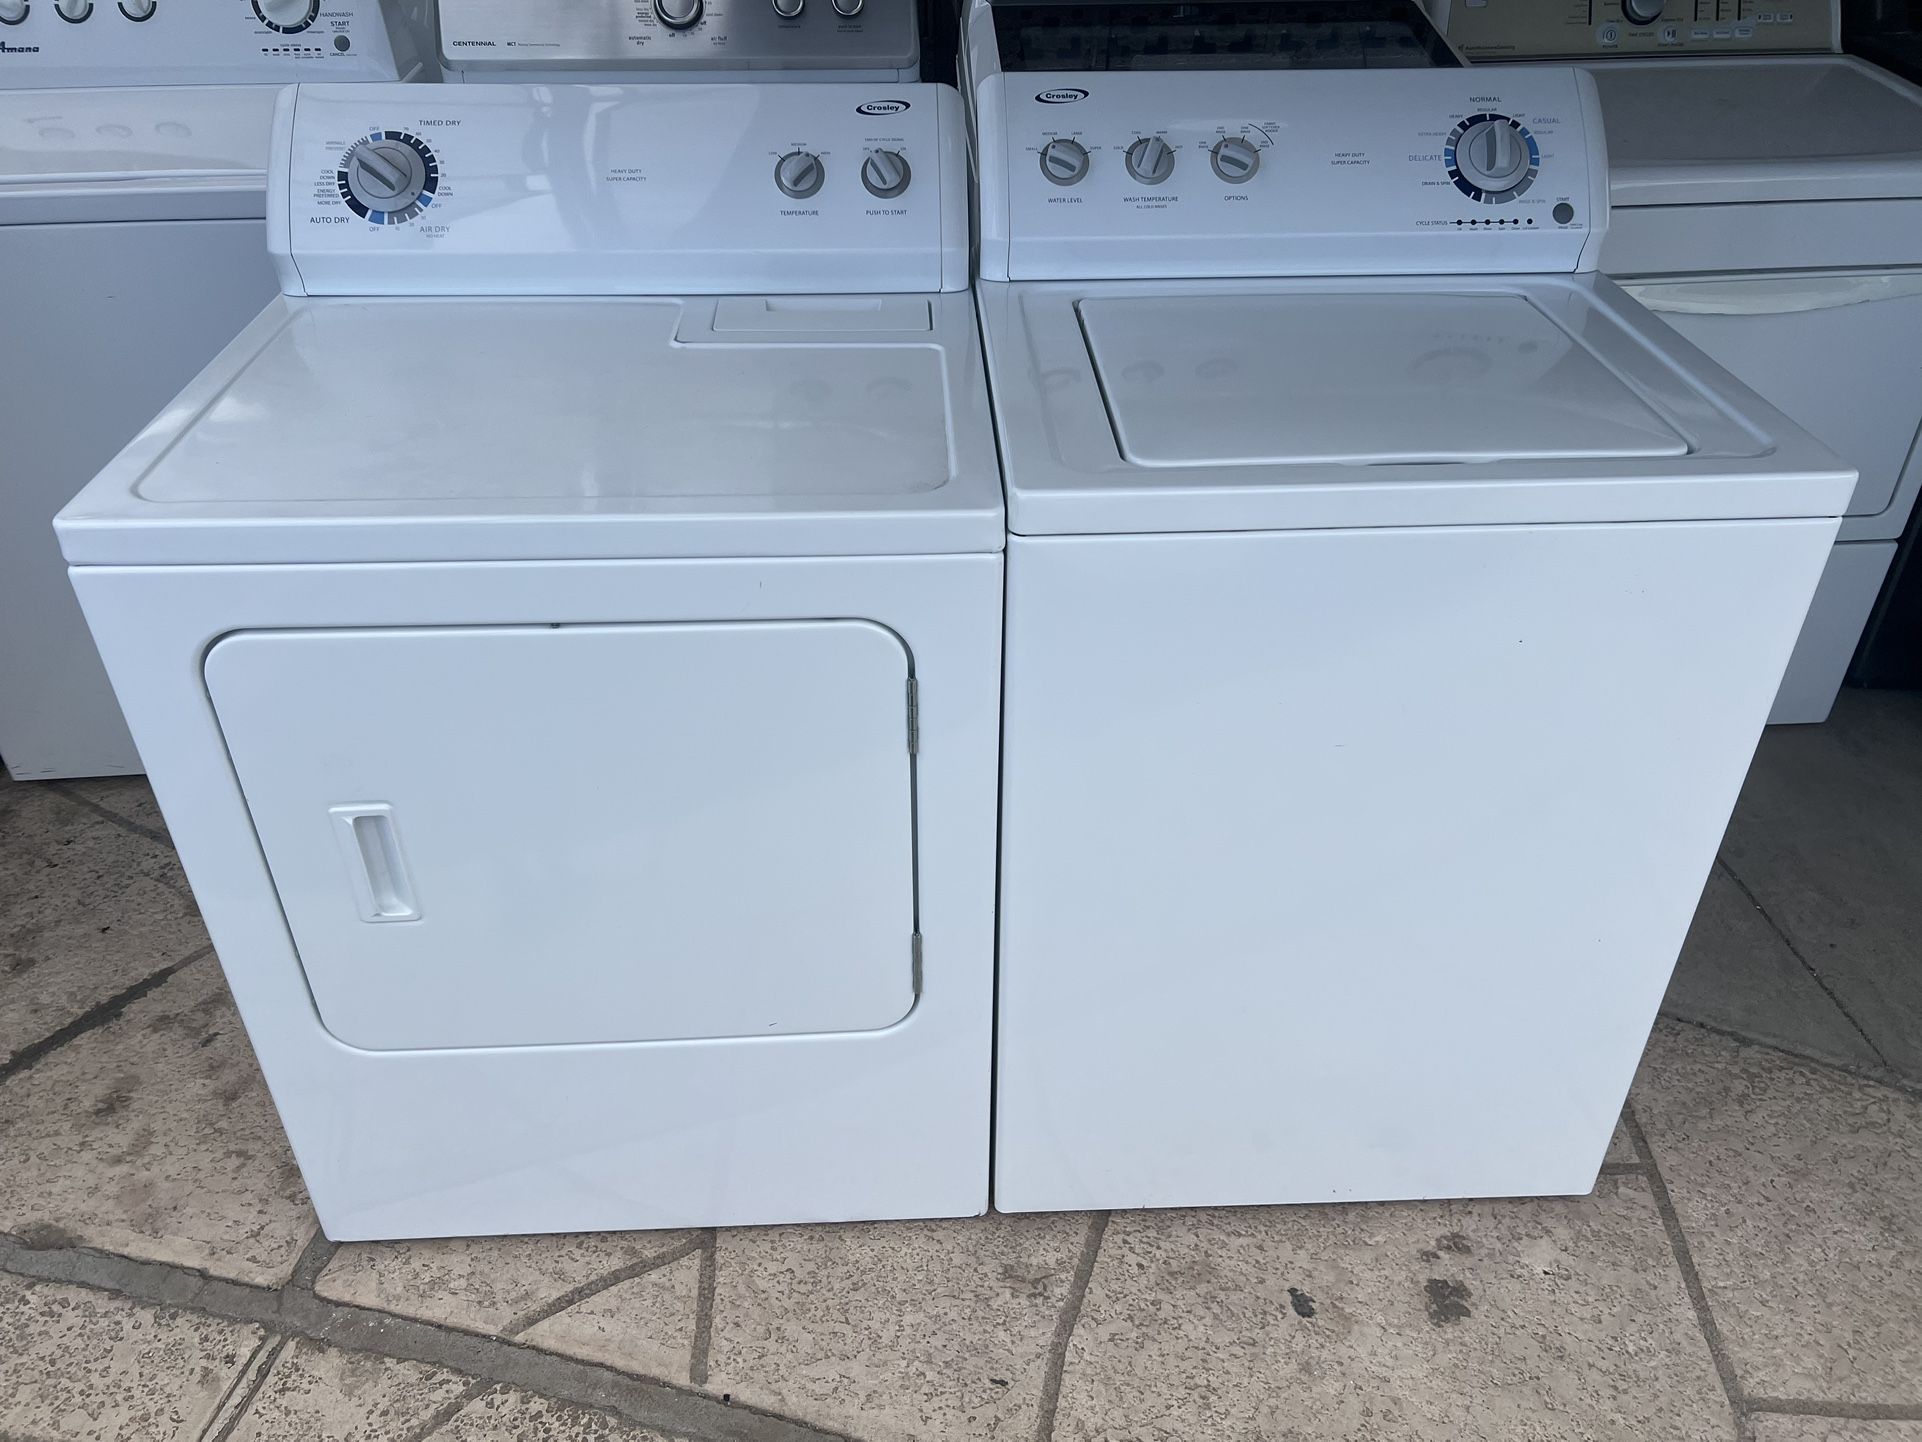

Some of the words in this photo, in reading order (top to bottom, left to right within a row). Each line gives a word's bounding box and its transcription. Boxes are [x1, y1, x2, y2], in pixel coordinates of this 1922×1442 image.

[866, 104, 900, 112] Crosley
[1408, 154, 1442, 162] DELICATE
[419, 225, 433, 233] AIR
[434, 225, 450, 233] DRY
